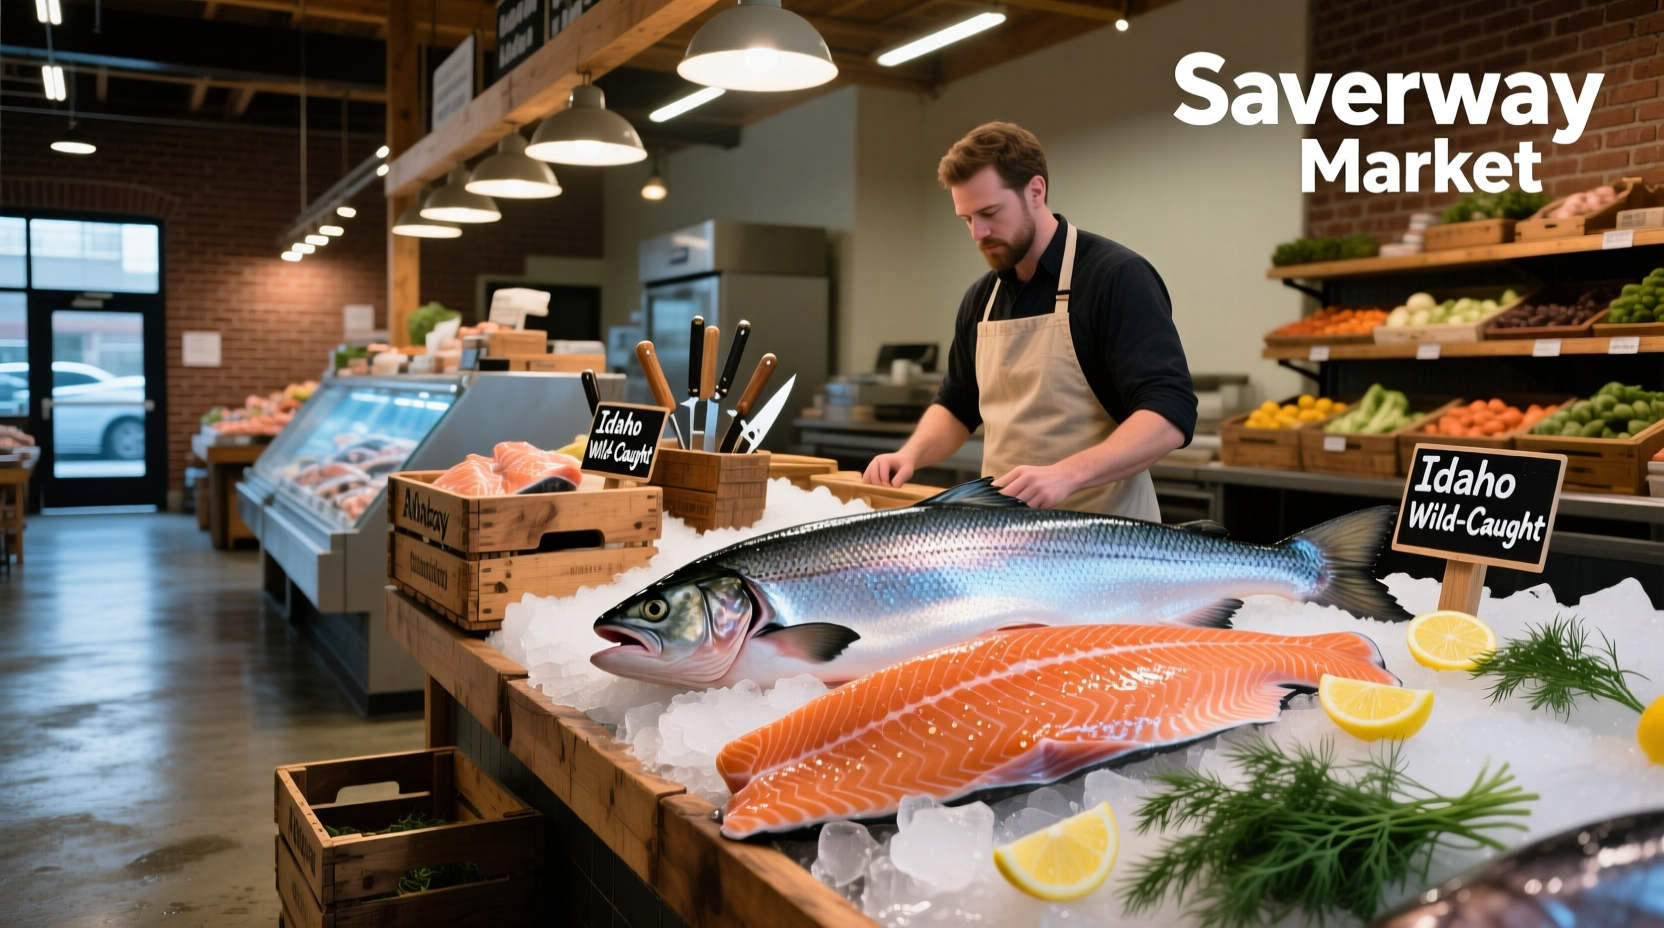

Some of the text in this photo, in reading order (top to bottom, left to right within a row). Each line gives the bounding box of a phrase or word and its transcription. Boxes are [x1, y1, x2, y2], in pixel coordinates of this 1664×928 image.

[595, 410, 642, 436] Idaho
[1414, 455, 1516, 499] Idaho
[1409, 500, 1546, 550] Wild-Caught
